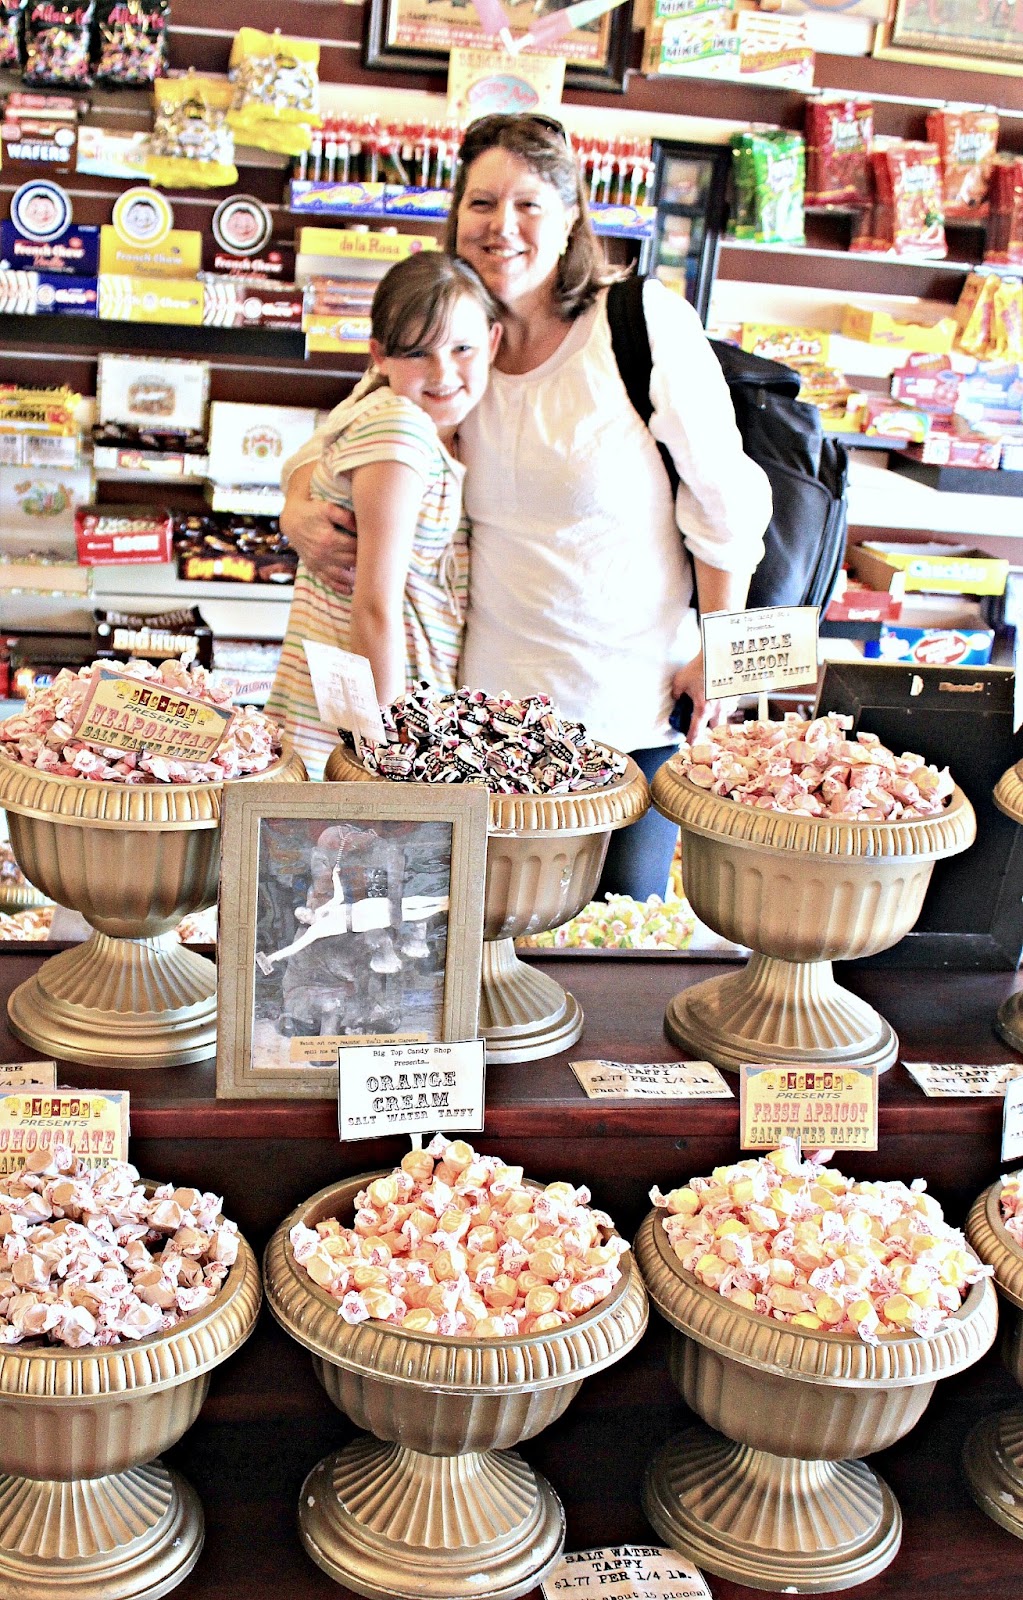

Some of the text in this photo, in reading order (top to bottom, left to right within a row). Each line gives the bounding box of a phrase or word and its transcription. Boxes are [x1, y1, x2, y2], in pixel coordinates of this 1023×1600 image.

[666, 37, 736, 57] MIKE IKE
[7, 142, 71, 163] WAFERS
[355, 236, 365, 251] la
[369, 237, 400, 255] Rosa
[113, 628, 200, 654] BIG HUNK
[731, 633, 792, 656] MAPLE
[733, 653, 790, 674] BACON
[712, 665, 811, 687] SALT WATER TAFFY
[123, 704, 192, 729] PRESENTS
[167, 701, 199, 723] TOP
[88, 703, 217, 749] NEAPOLITAN
[82, 726, 207, 760] SALT WATER TAFFY
[407, 1047, 429, 1056] Candy
[434, 1046, 452, 1054] Shop
[366, 1071, 457, 1092] ORANGE
[590, 1075, 624, 1083] $1.77
[629, 1075, 659, 1083] PER
[780, 1073, 843, 1090] BIG TOP
[23, 1099, 90, 1117] BIG TOP
[371, 1092, 450, 1113] CREAM
[753, 1102, 868, 1123] FRESH APRICOT
[348, 1108, 474, 1126] SALT WATER TAFFY
[0, 1128, 116, 1155] CHOCOLATE
[750, 1126, 782, 1144] SALT
[831, 1127, 870, 1144] TAFFY
[0, 1156, 26, 1174] ALT
[564, 1547, 662, 1563] SALT WATER
[592, 1559, 644, 1573] TAFFY
[555, 1569, 692, 1589] $1.77 PER 1/4 lb.
